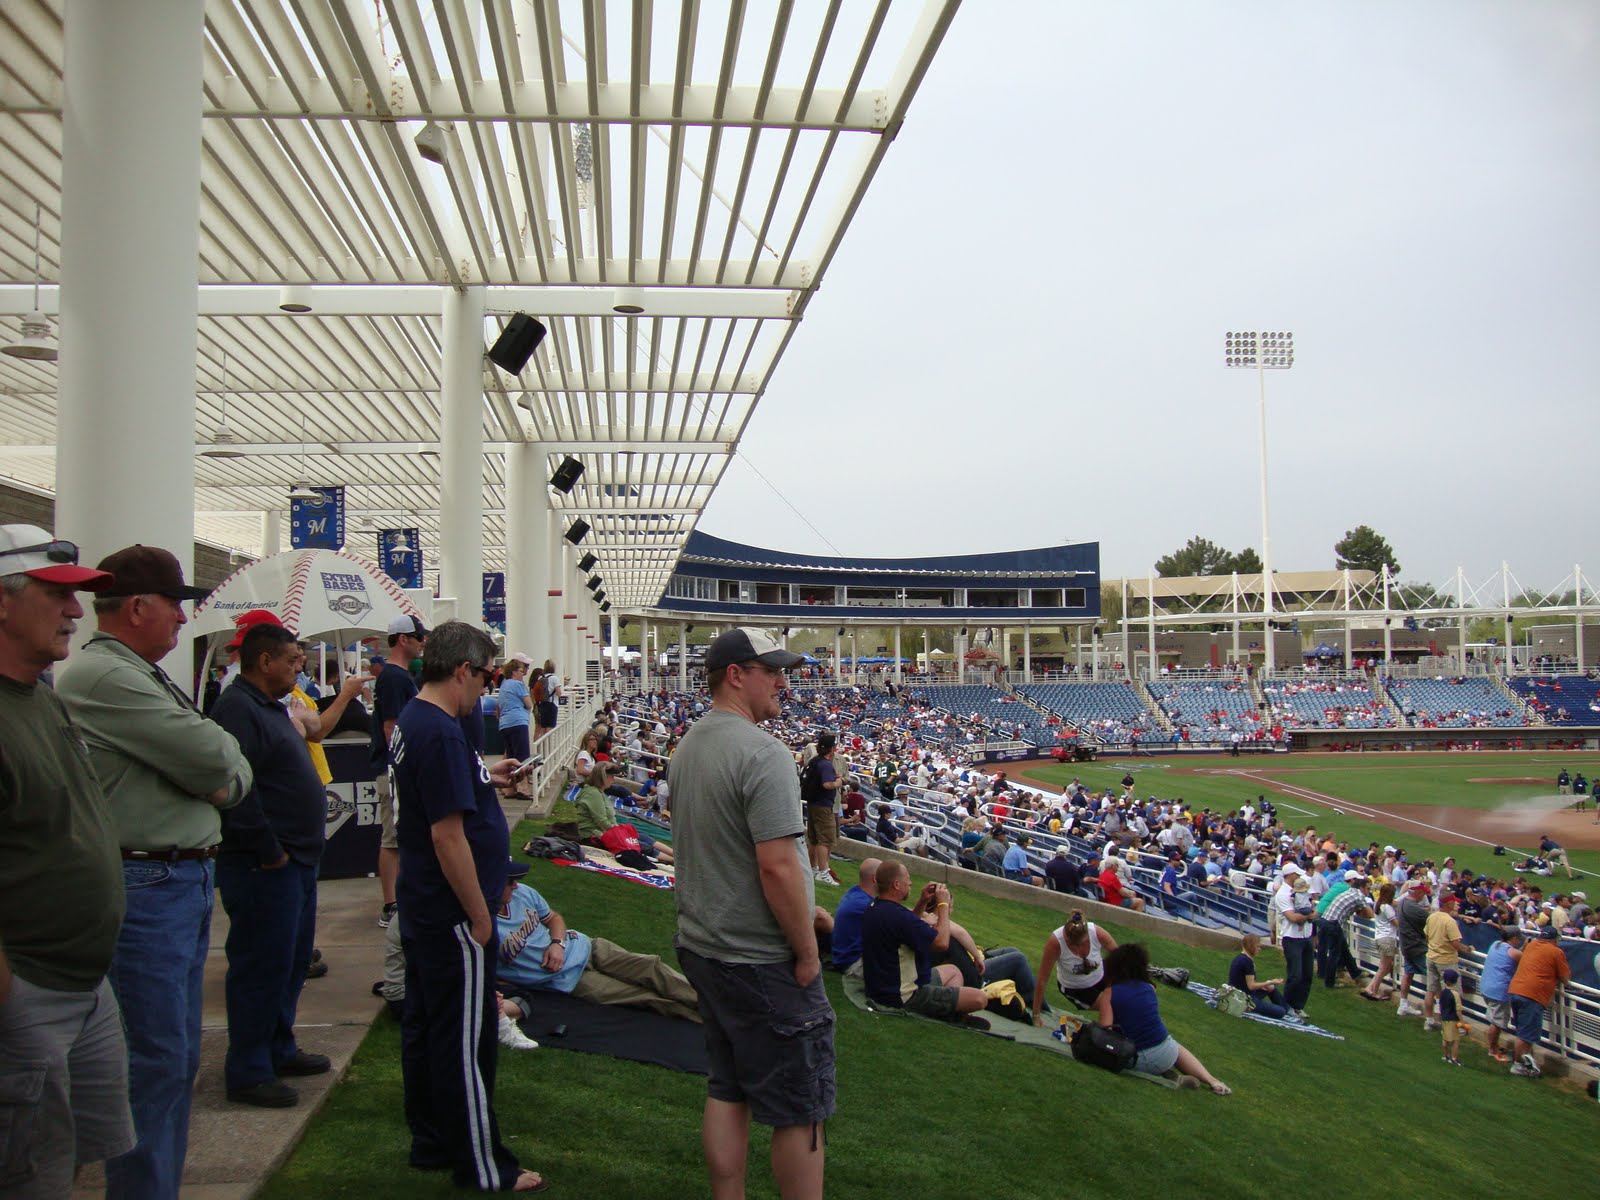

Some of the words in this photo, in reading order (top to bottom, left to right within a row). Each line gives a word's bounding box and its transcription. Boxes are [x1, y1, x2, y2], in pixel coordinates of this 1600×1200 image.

[320, 572, 364, 582] EXTRA
[322, 580, 366, 590] BASES
[484, 577, 496, 594] 7
[214, 601, 234, 609] Bank
[244, 600, 278, 610] America
[878, 766, 888, 778] 12
